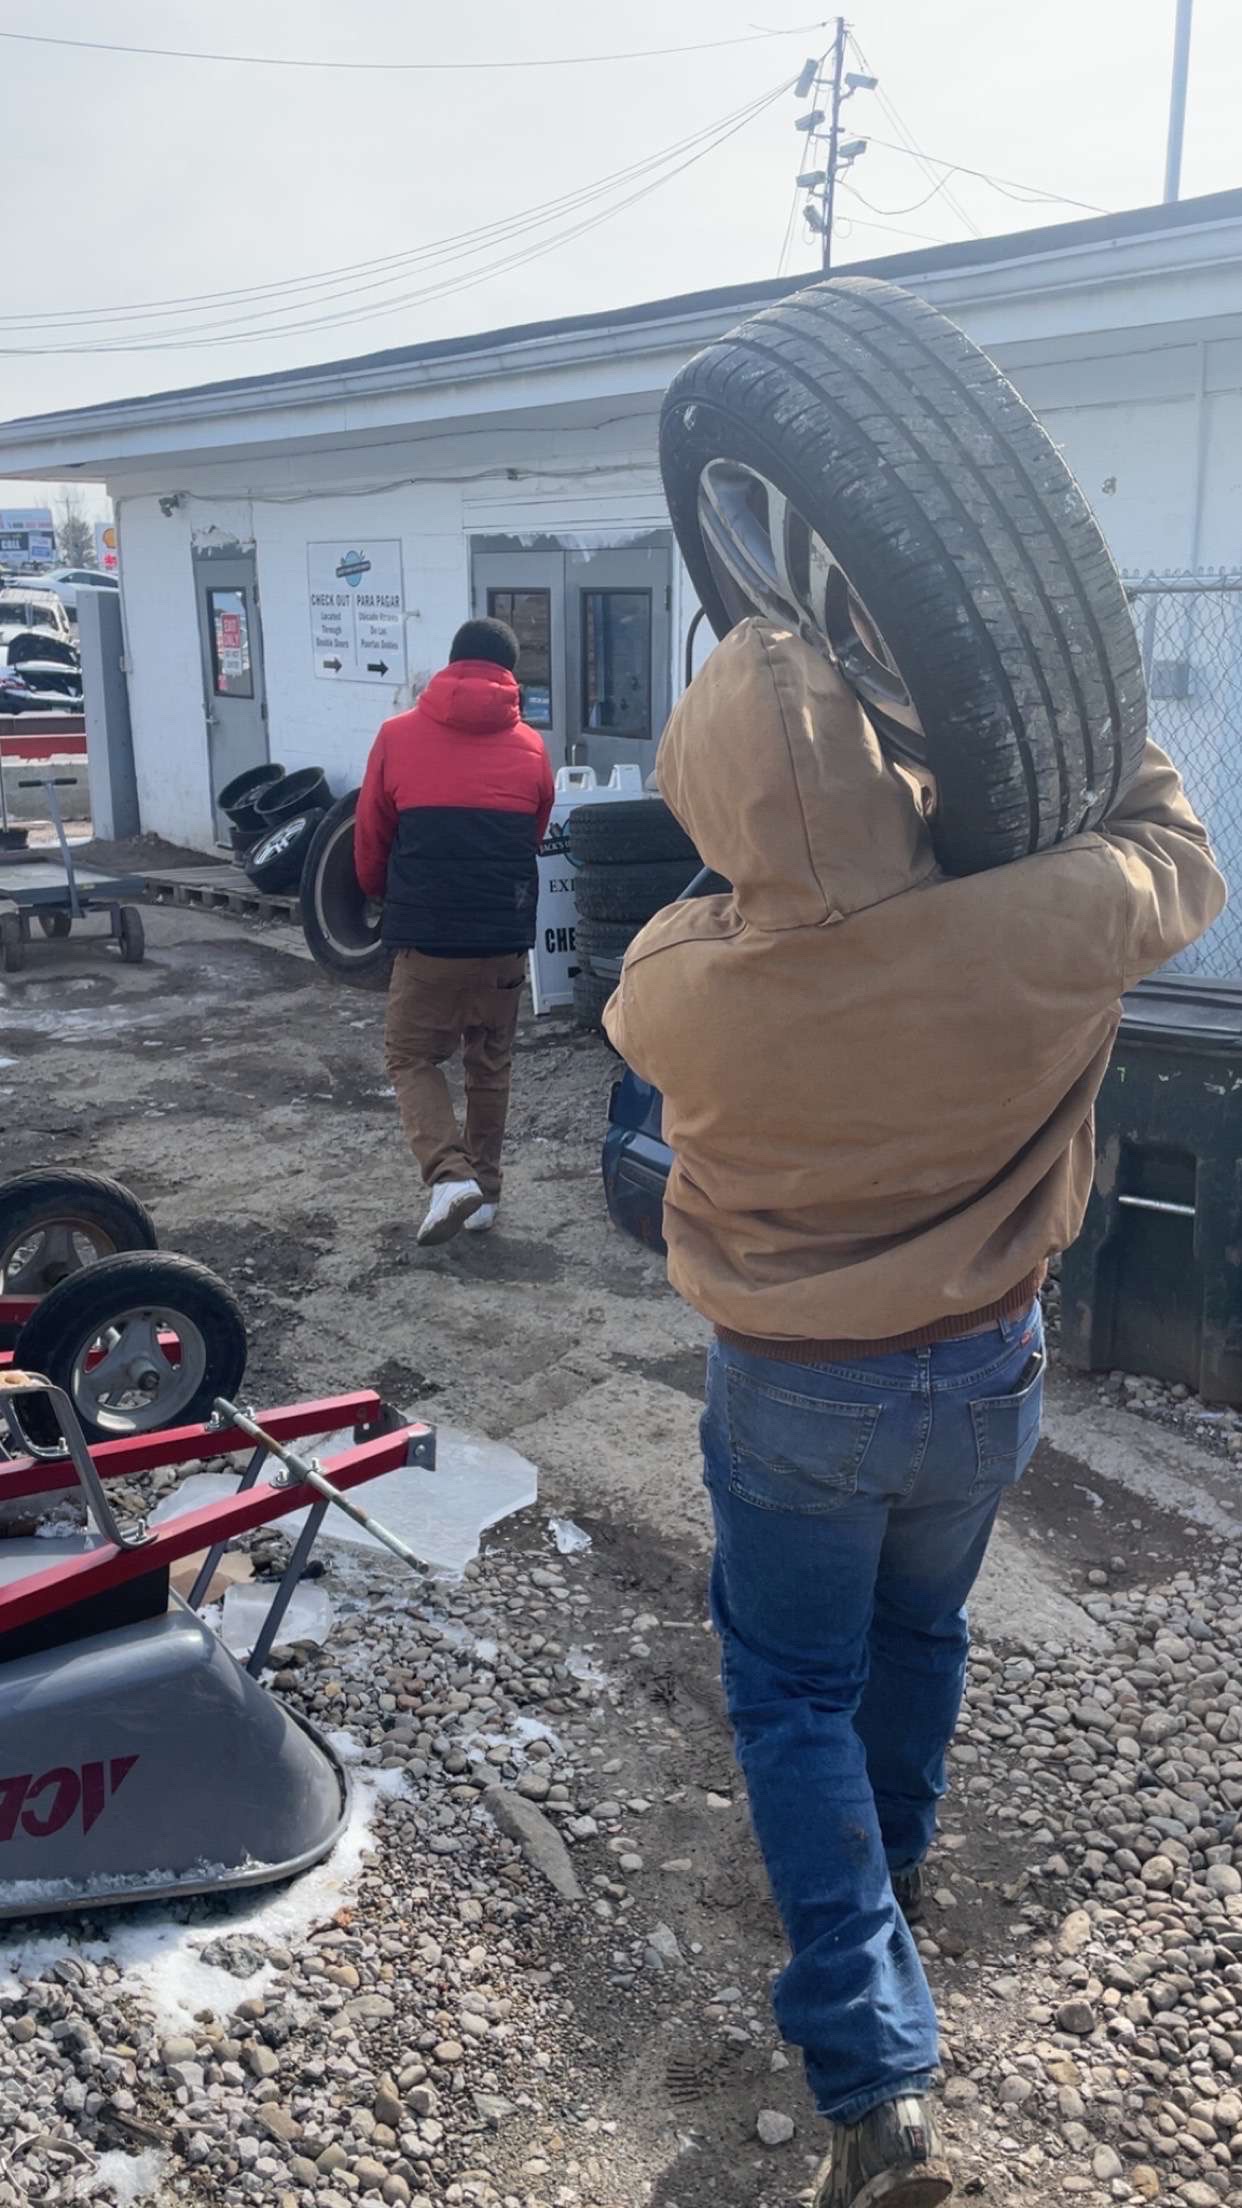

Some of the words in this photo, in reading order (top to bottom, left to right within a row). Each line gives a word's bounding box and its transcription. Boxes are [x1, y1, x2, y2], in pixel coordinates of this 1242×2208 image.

[312, 594, 335, 606] CHECK
[336, 594, 350, 607] OUT
[357, 594, 375, 606] PARA
[376, 594, 400, 607] PAGAR
[545, 927, 576, 954] CHE
